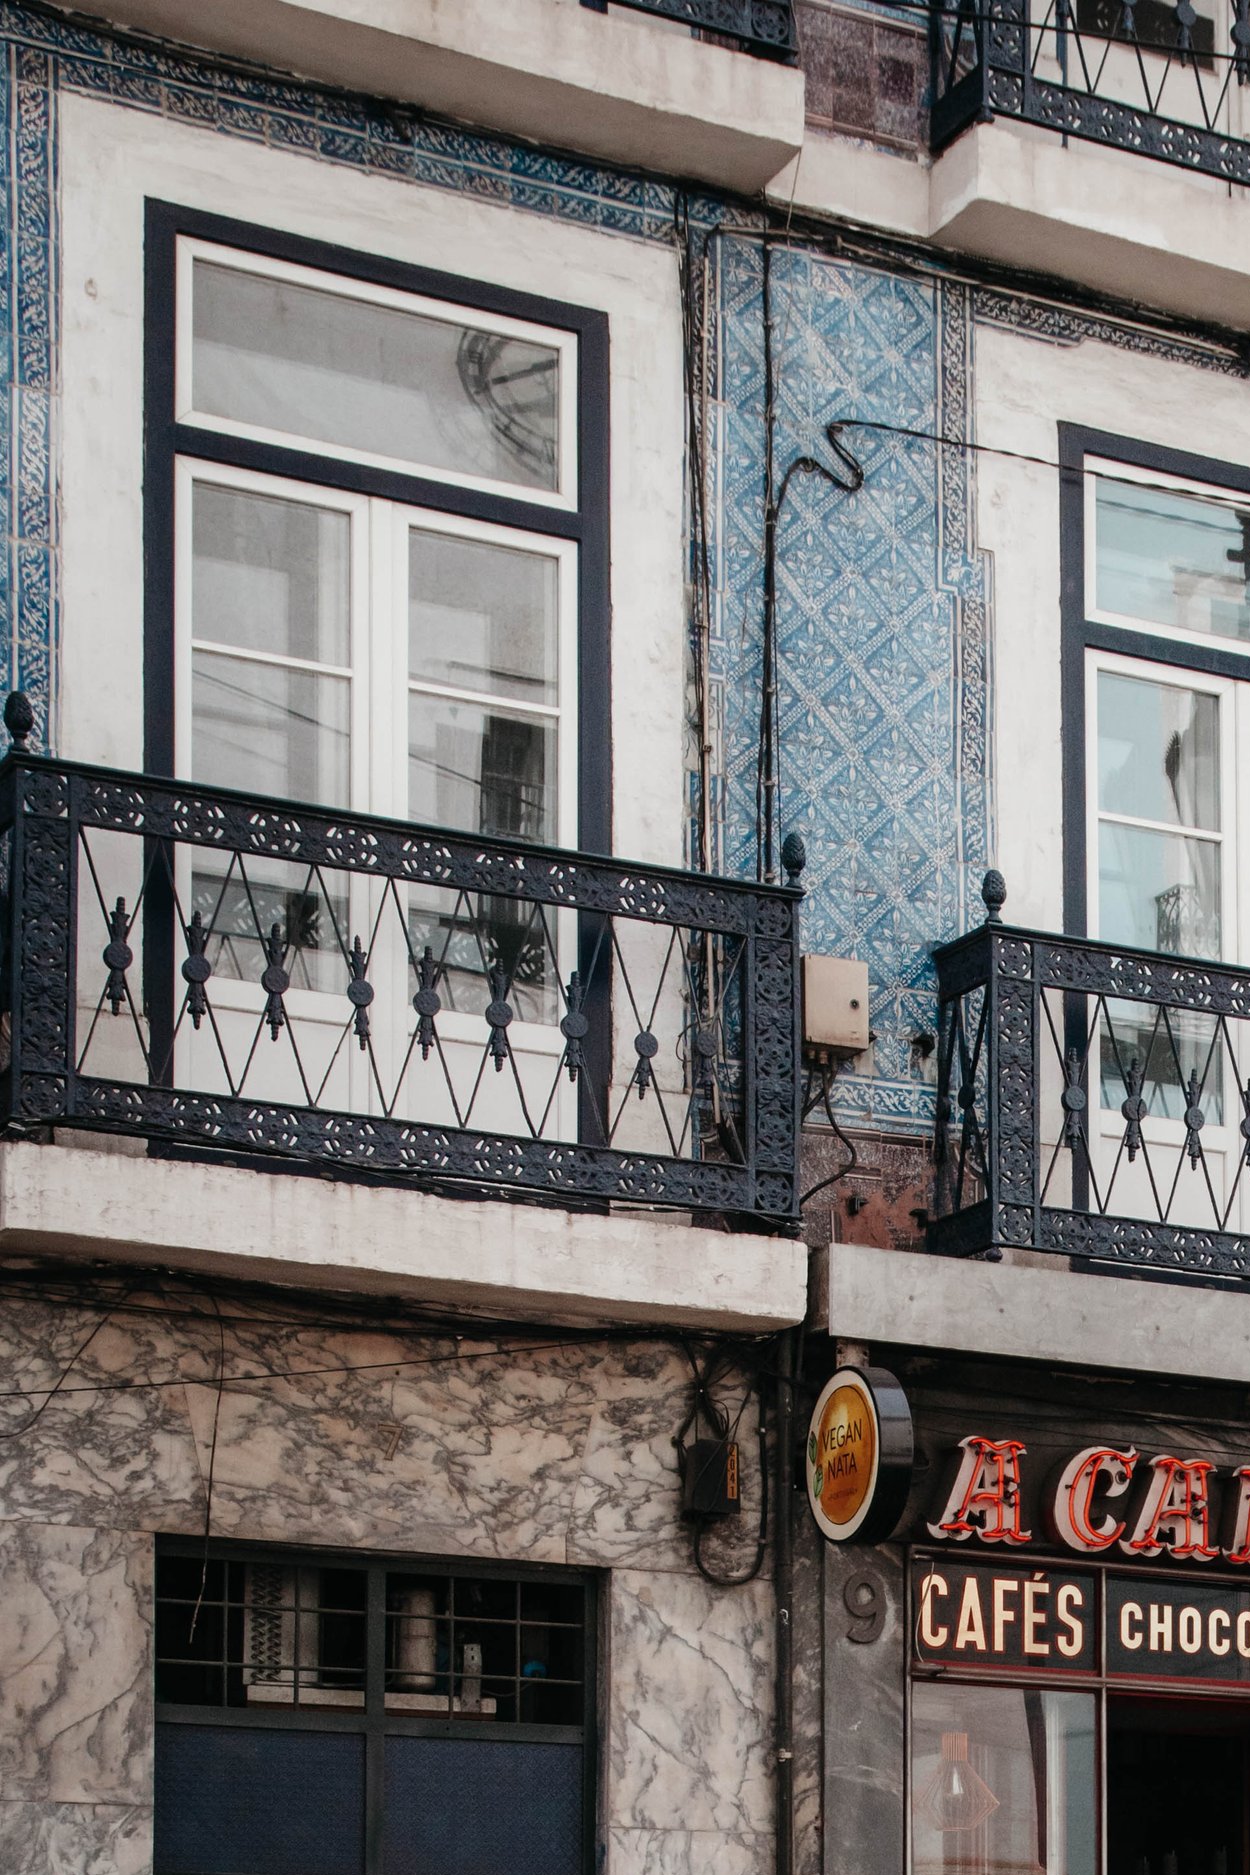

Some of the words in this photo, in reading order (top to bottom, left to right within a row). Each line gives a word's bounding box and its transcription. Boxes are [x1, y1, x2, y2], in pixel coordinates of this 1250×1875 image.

[377, 1423, 406, 1461] 7
[821, 1418, 863, 1452] VEGAN
[728, 1444, 737, 1498] 2041
[827, 1452, 858, 1483] NATA
[927, 1436, 1033, 1546] A
[844, 1571, 888, 1643] 9
[920, 1571, 1084, 1658] CAFÉS
